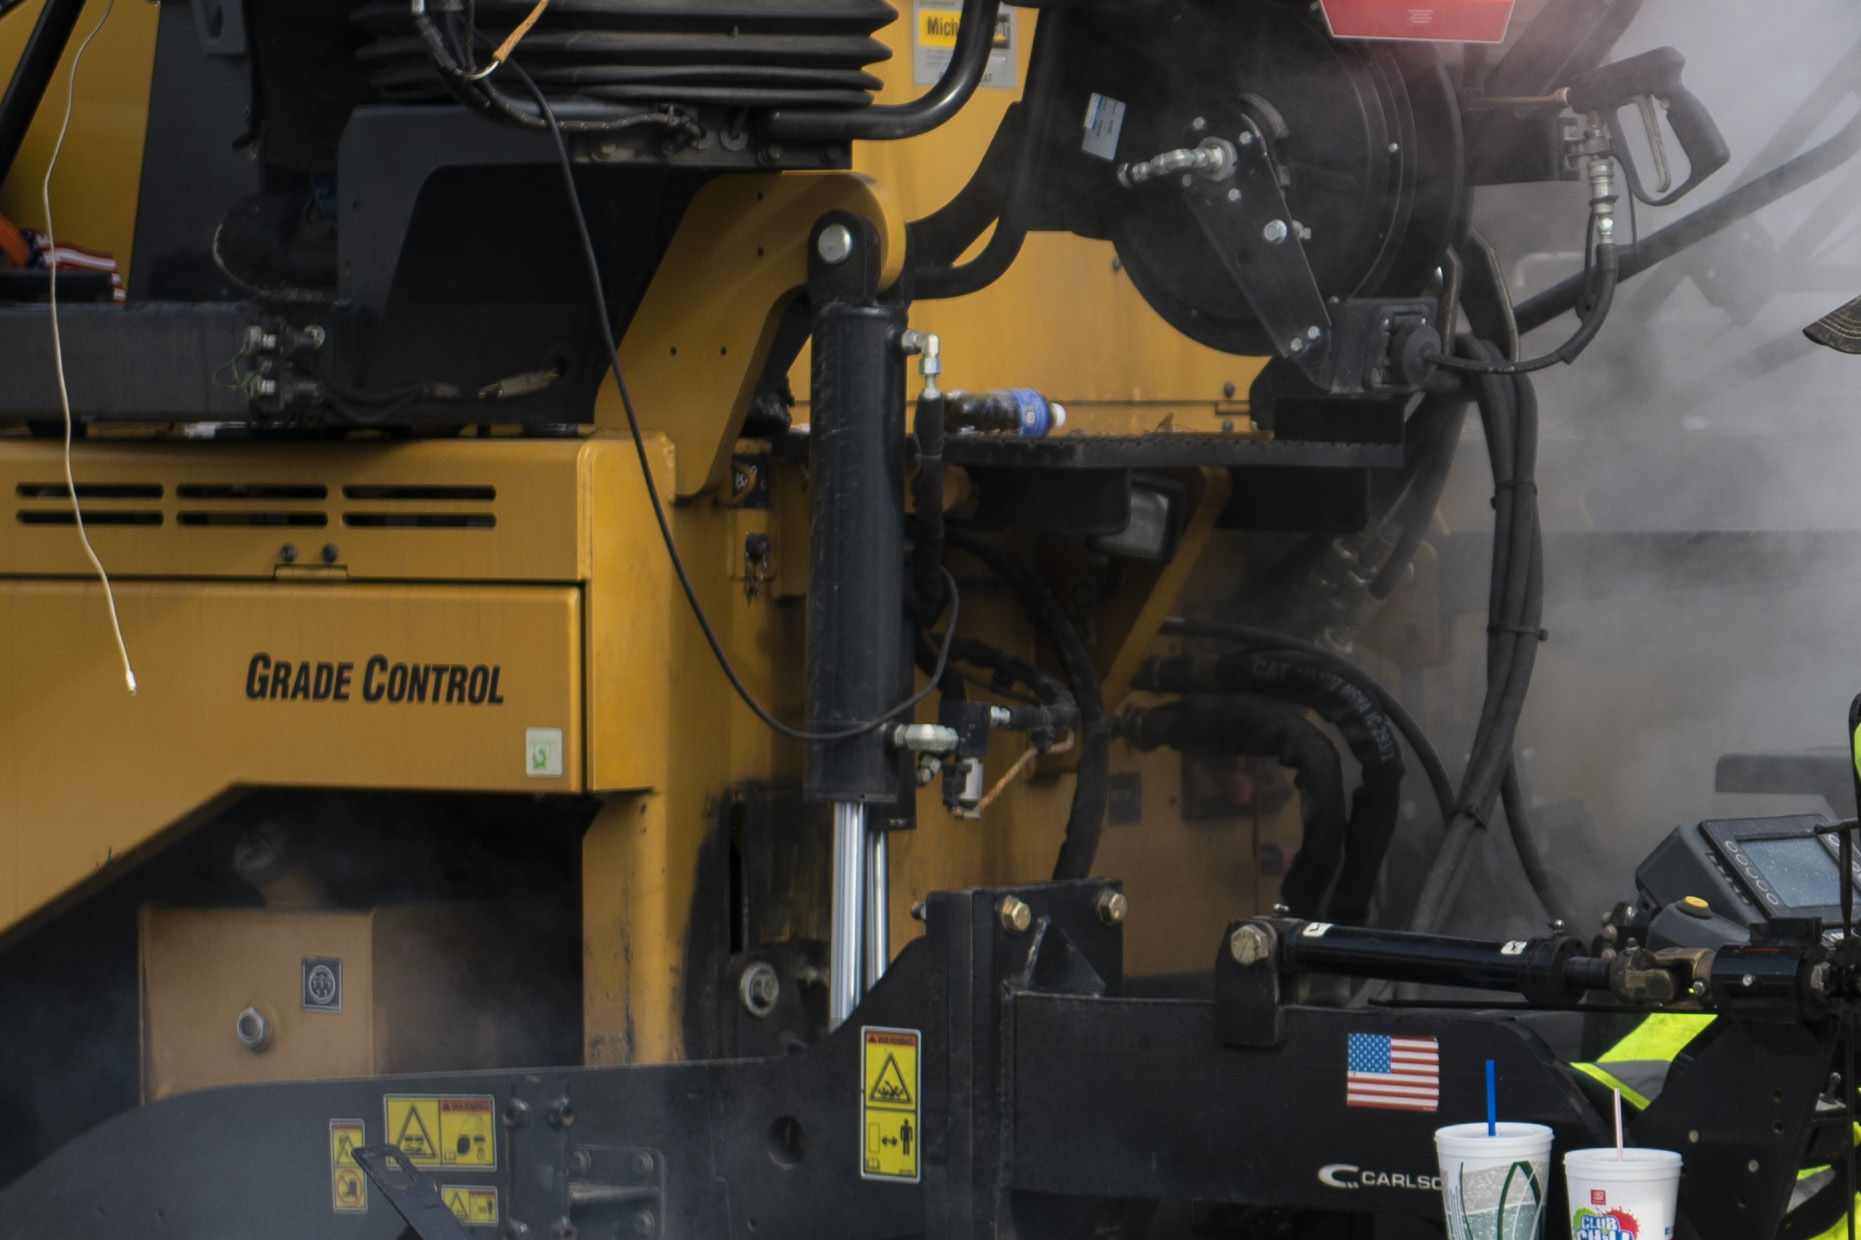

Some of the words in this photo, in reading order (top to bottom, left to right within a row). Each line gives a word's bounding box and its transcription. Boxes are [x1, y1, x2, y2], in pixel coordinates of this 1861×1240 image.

[246, 652, 353, 701] GRADE
[363, 654, 504, 704] CONTROL
[1361, 1170, 1442, 1191] CARLSO
[1581, 1215, 1618, 1230] CLUB
